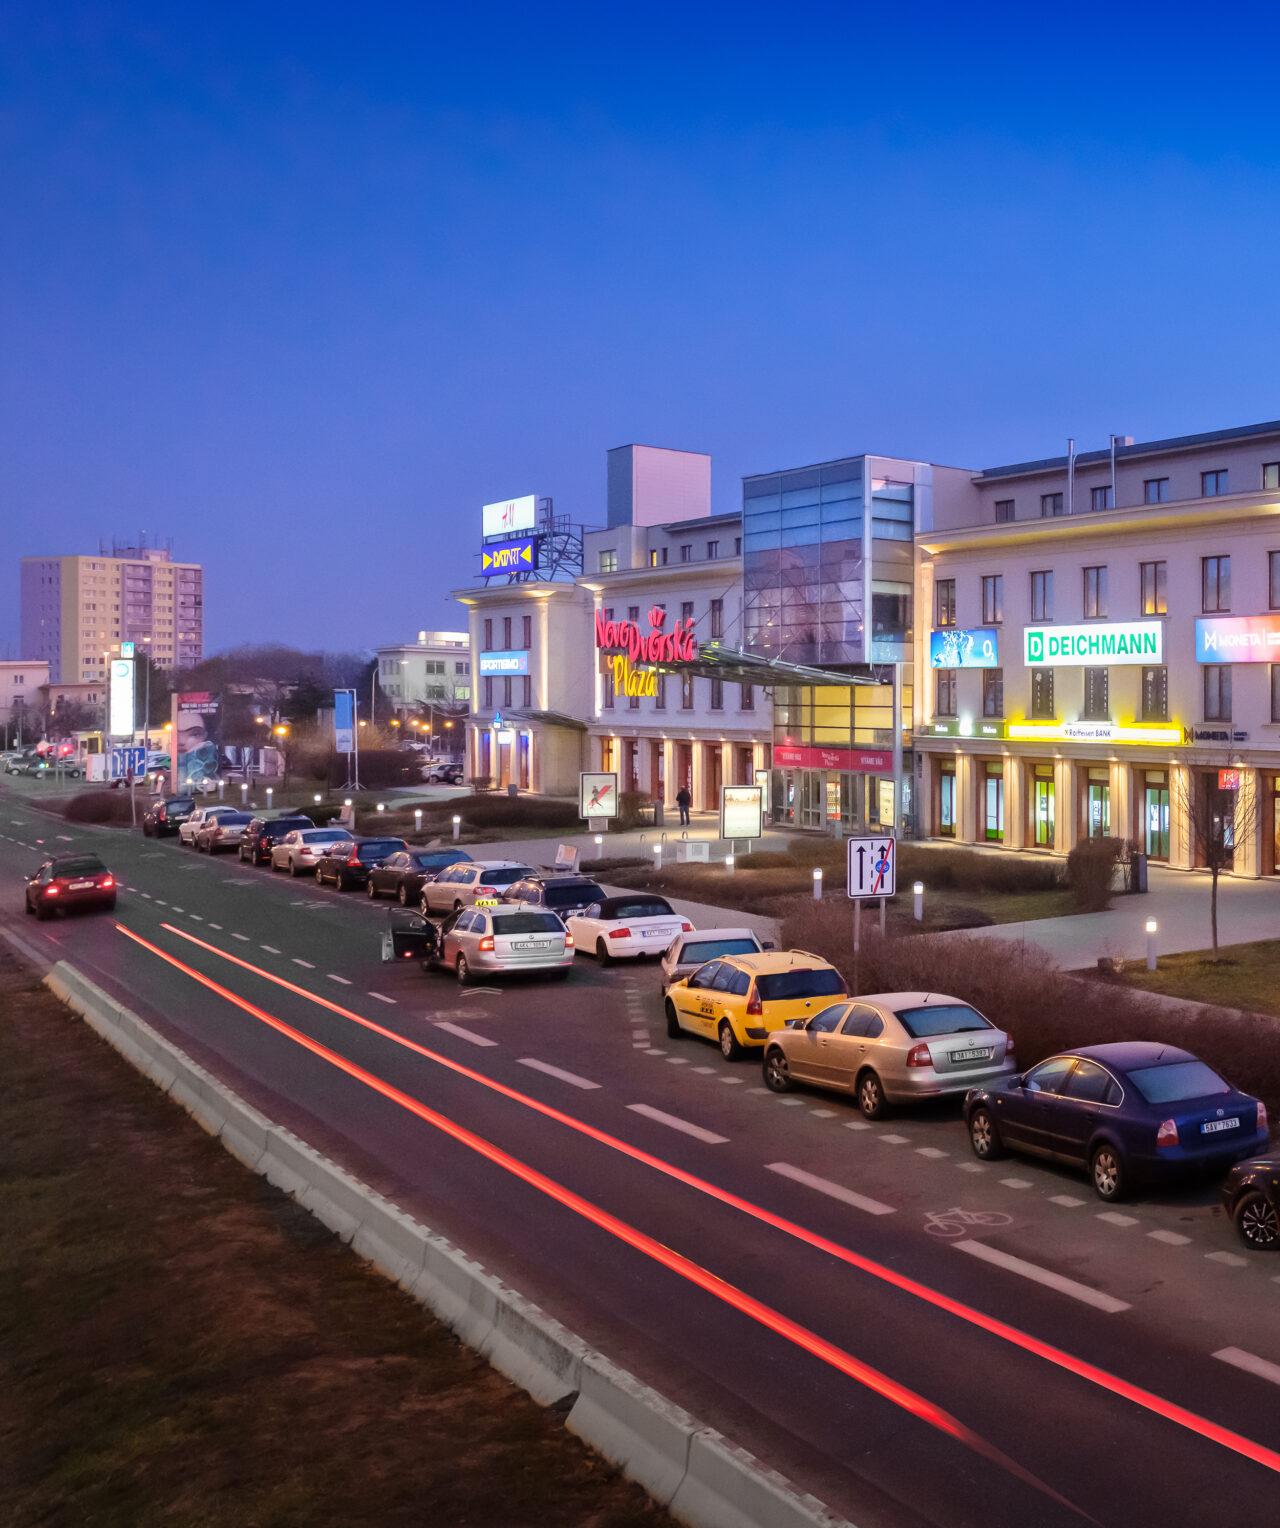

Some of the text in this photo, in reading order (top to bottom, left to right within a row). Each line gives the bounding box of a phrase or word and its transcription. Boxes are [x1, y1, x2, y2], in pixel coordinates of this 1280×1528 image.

[493, 548, 521, 568] DATART
[1049, 633, 1156, 656] DEICHMANN
[1218, 633, 1261, 647] MONETA
[614, 655, 656, 696] Plaza
[1095, 729, 1111, 737] BANK
